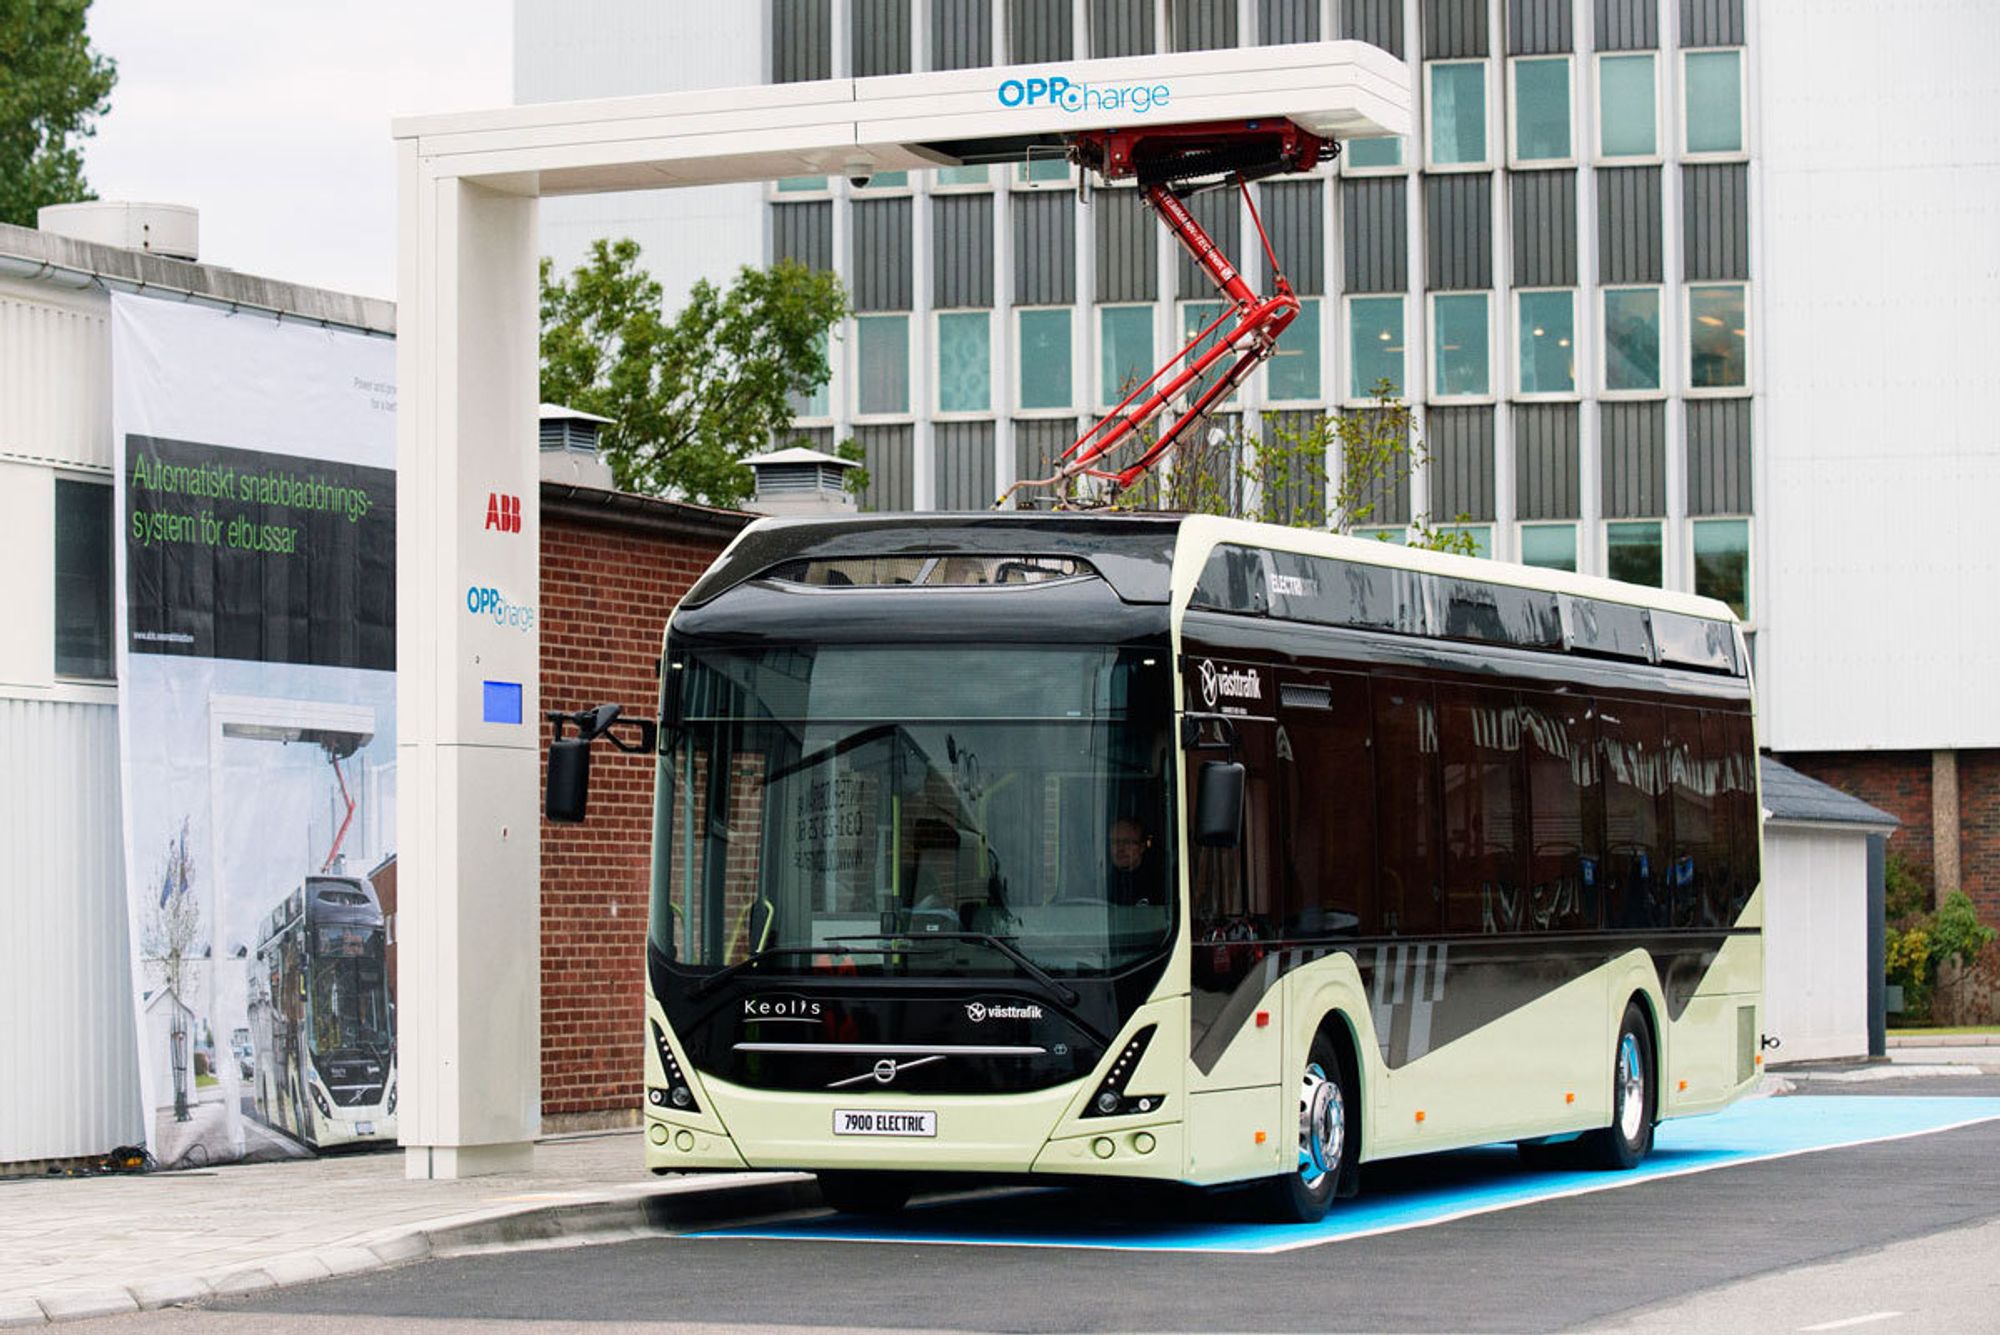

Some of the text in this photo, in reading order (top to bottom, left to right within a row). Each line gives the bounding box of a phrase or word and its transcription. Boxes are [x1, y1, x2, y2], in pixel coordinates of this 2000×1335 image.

[132, 453, 373, 523] Automatiskt snabbladdnings-
[485, 493, 521, 533] ABB
[132, 509, 297, 553] system för elbussar
[744, 1000, 820, 1015] Keolis
[988, 1004, 1043, 1018] västtrafik
[844, 1114, 925, 1132] 7900 ELECTRIC
